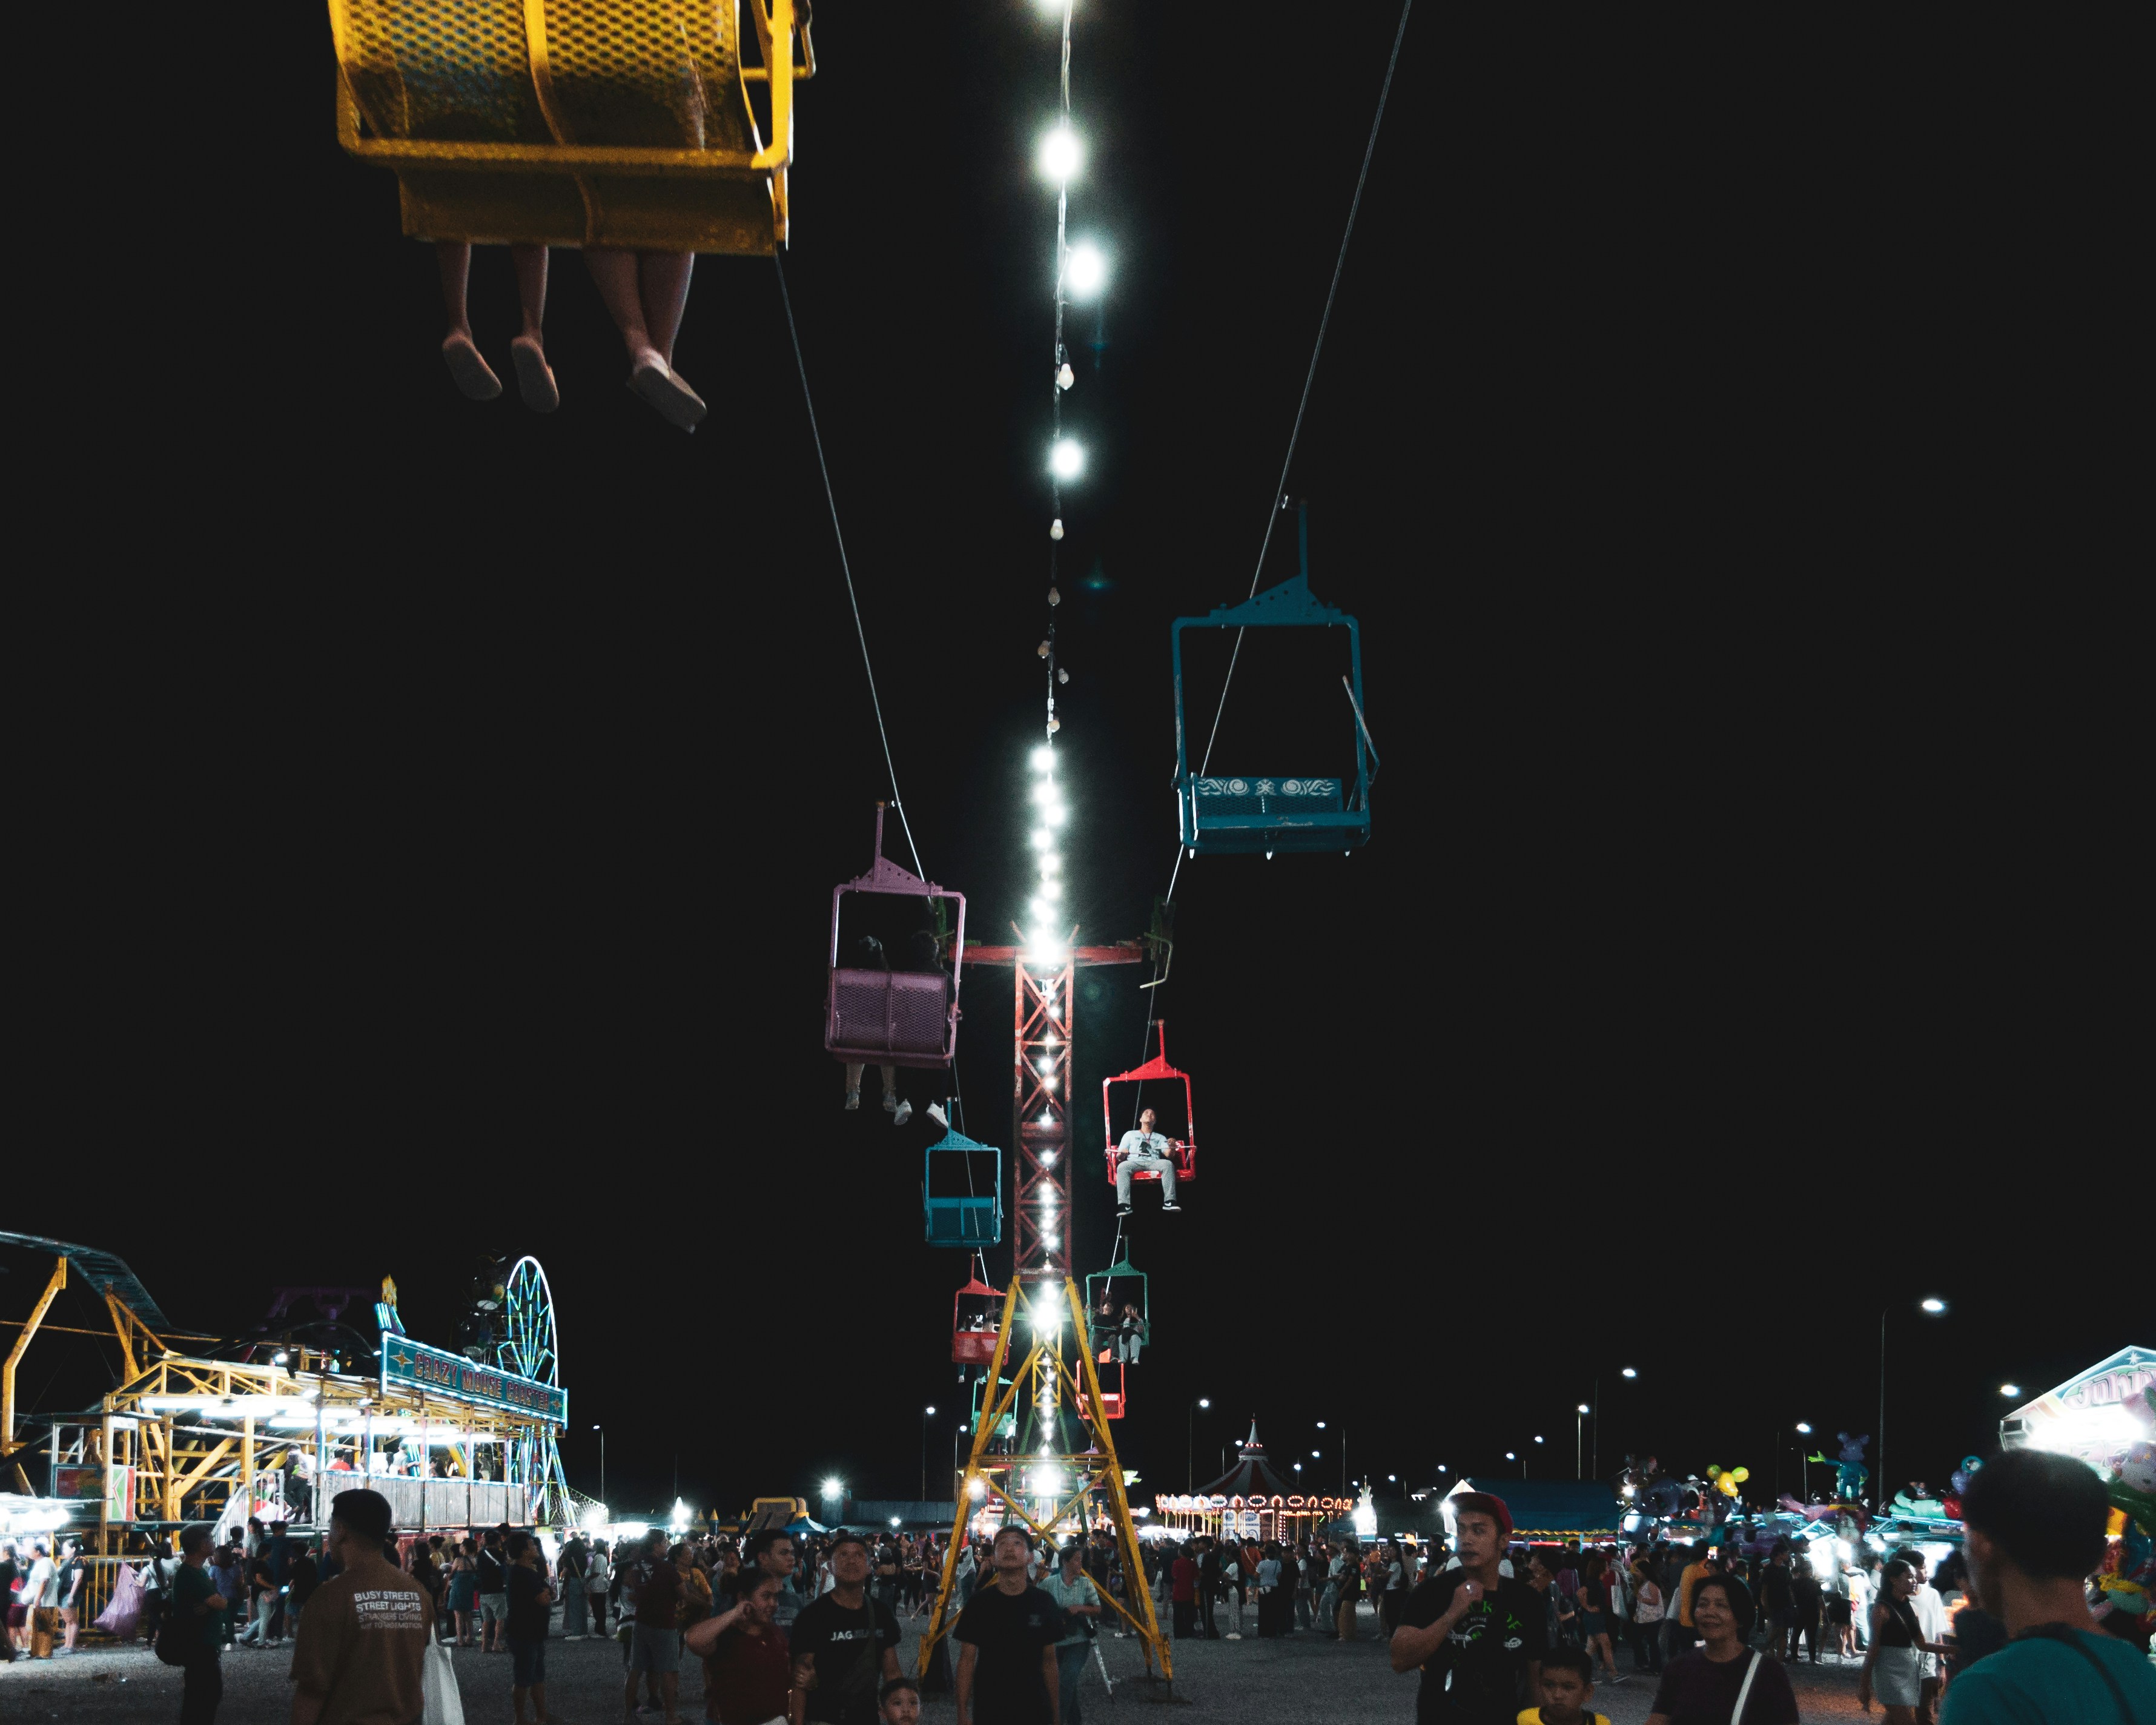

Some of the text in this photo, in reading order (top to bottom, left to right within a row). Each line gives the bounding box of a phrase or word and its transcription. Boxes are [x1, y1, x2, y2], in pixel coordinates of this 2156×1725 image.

[414, 1351, 549, 1411] CRAZY MOUSE COASTER
[354, 1591, 420, 1602] BUSY STREETS
[355, 1601, 422, 1613] STREET LIGHTS
